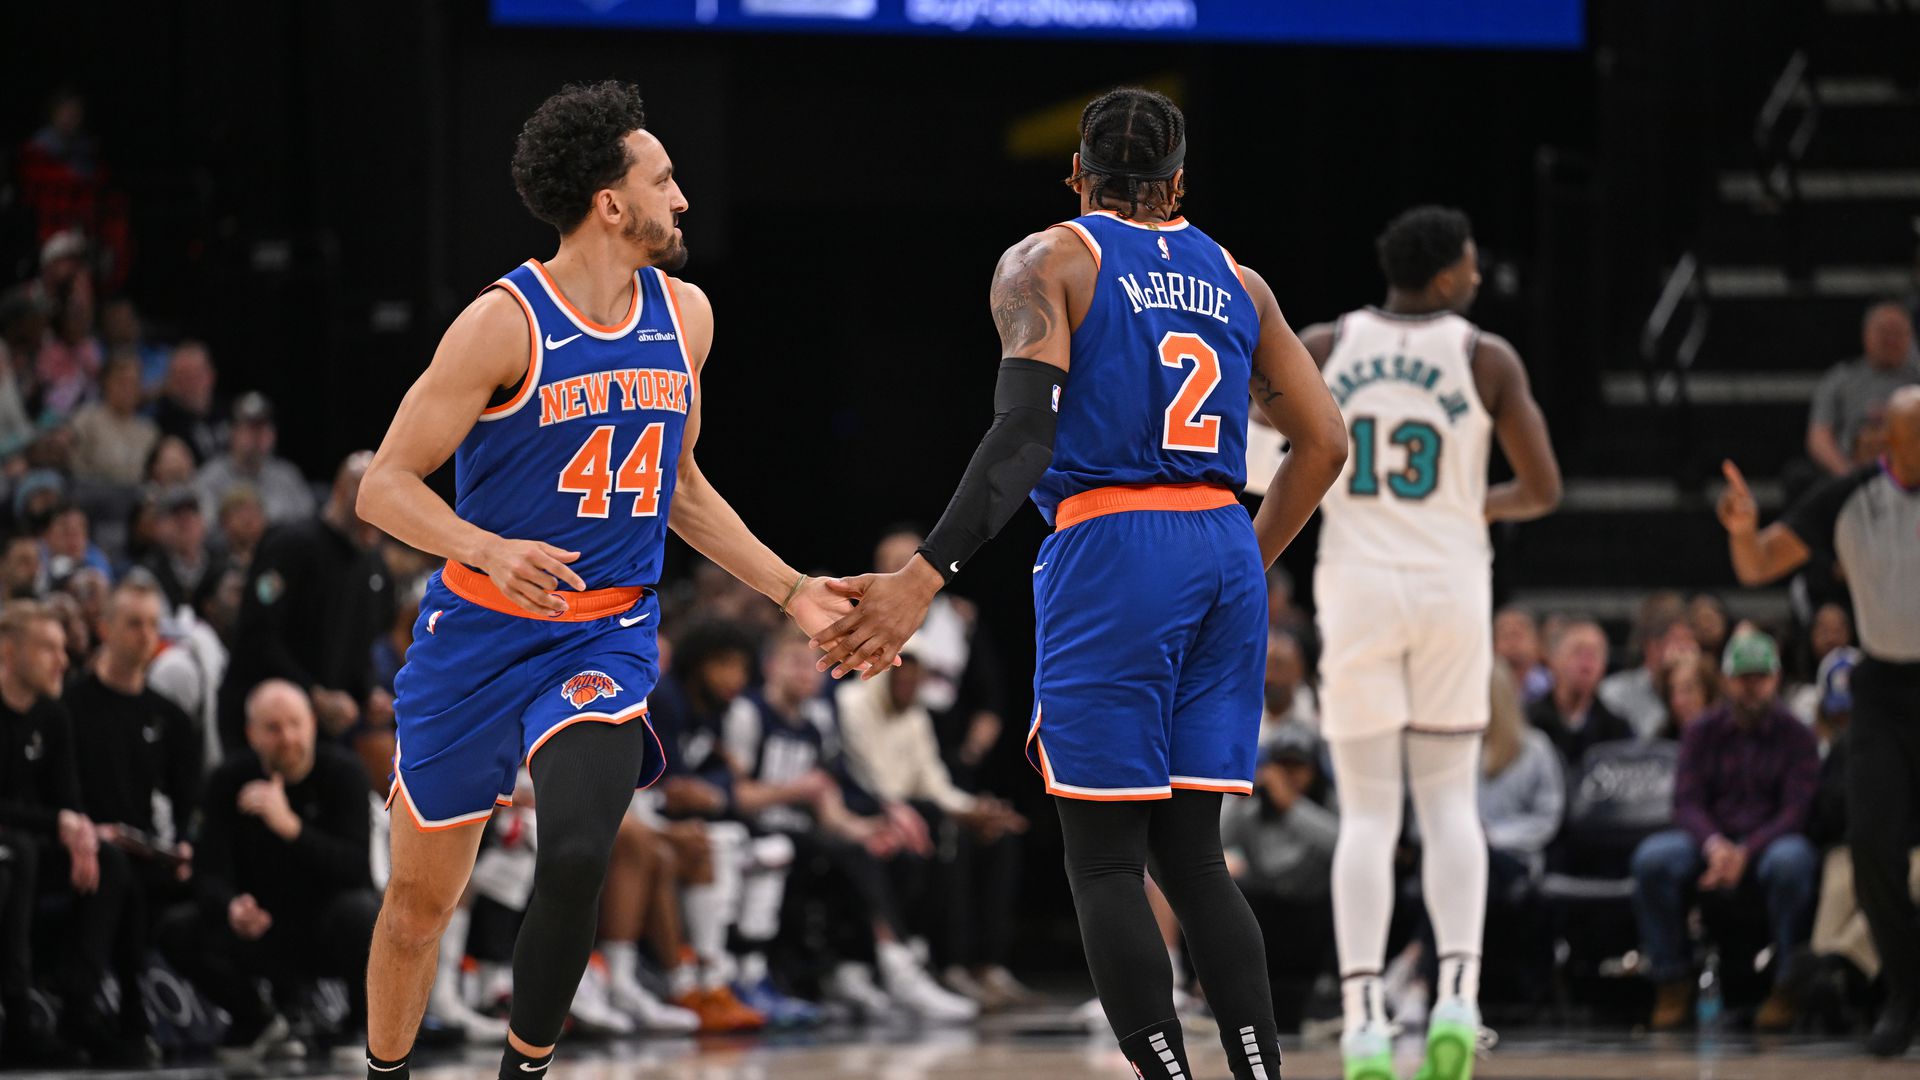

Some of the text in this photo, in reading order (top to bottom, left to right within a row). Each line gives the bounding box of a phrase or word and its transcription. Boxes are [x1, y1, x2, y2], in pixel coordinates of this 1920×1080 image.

[1118, 271, 1232, 324] McBRIDE
[538, 367, 689, 428] NEW YORK
[1158, 331, 1222, 454] 2
[557, 422, 665, 518] 44
[1348, 415, 1442, 500] 13
